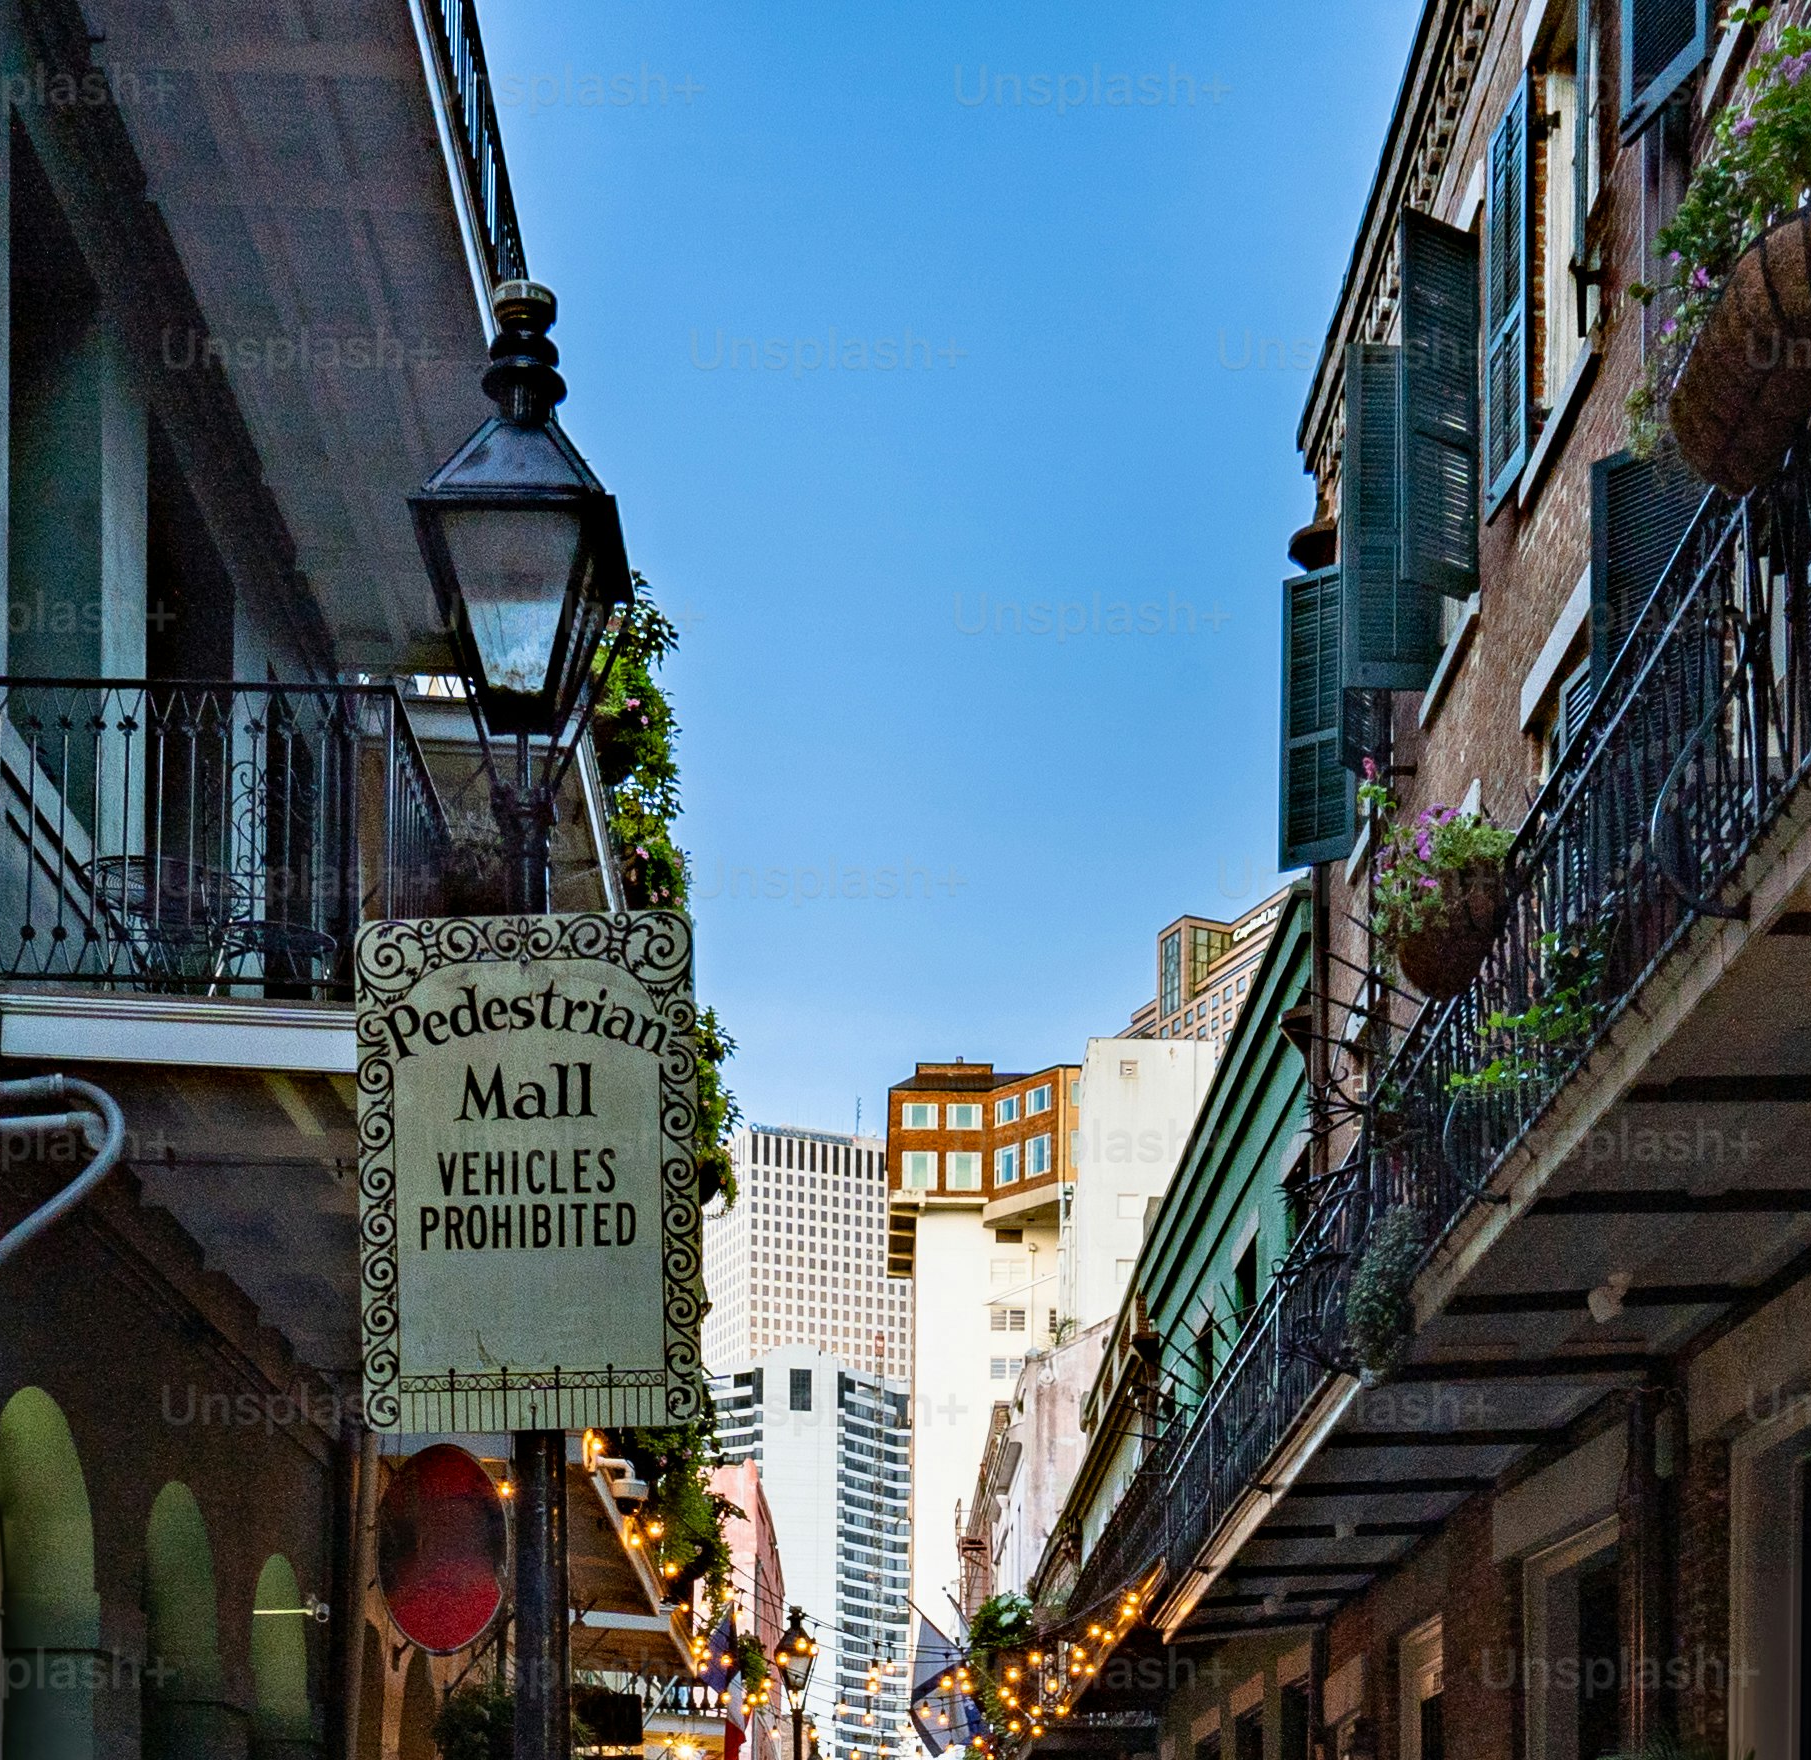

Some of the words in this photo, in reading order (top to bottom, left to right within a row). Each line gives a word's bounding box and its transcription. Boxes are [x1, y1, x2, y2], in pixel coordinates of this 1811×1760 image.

[380, 980, 669, 1060] Pedestrian
[455, 1062, 597, 1121] Mall
[437, 1147, 617, 1197] VEHICLES
[419, 1201, 637, 1252] PROHIBITED
